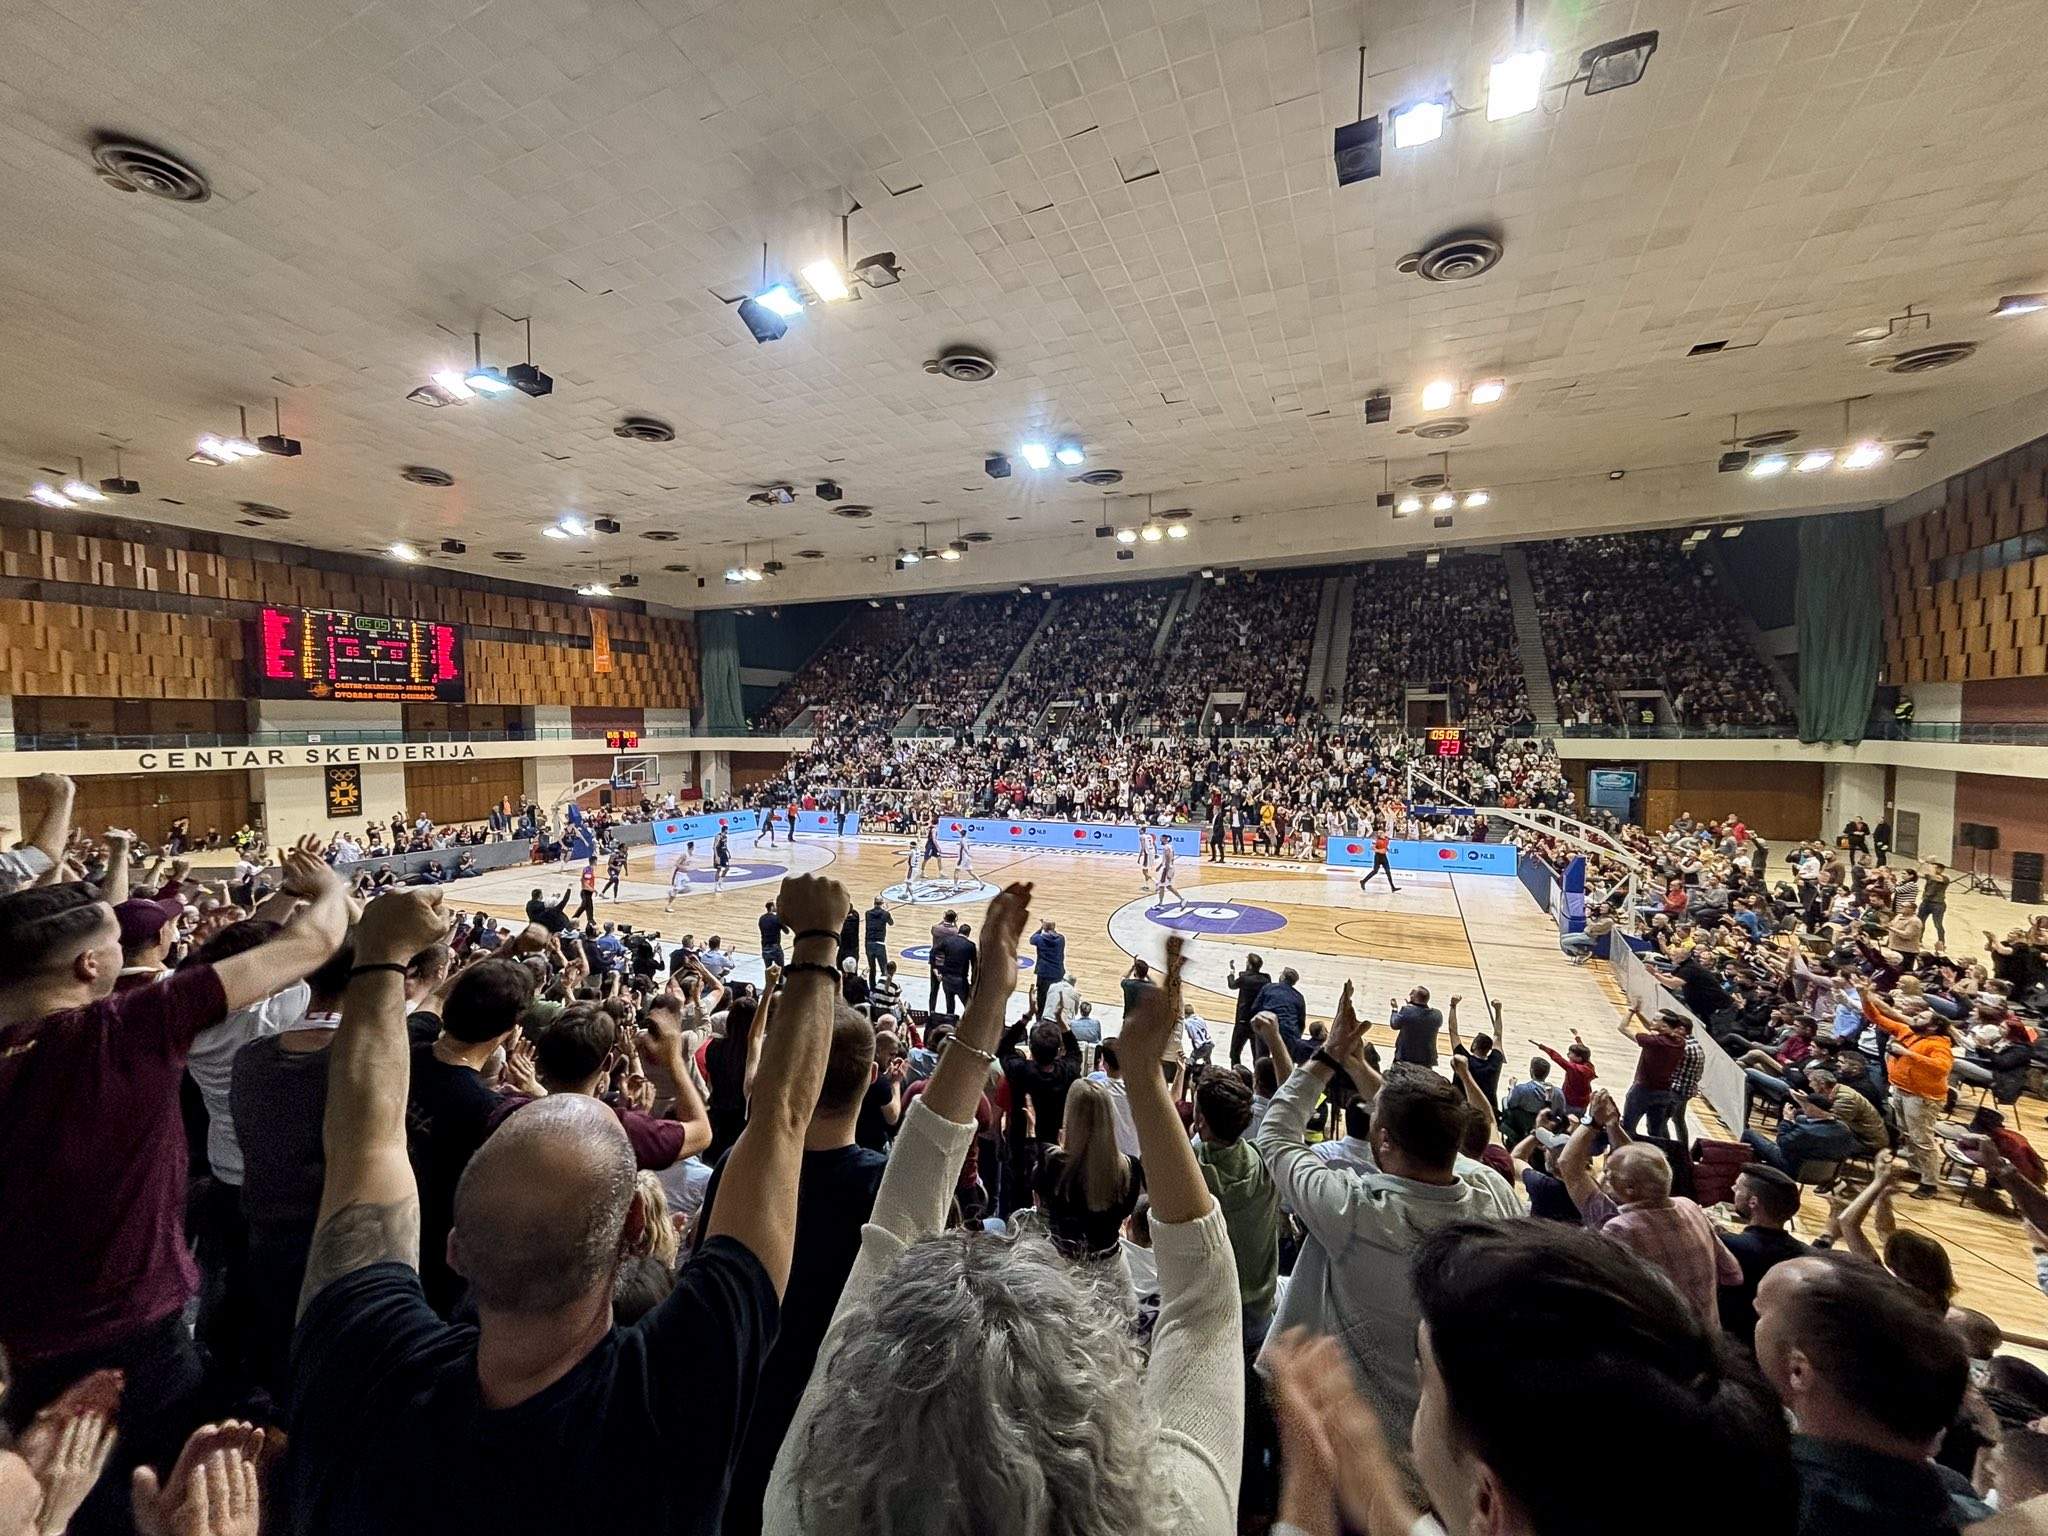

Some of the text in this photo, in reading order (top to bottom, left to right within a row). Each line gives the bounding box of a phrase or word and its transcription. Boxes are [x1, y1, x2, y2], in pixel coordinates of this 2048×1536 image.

[345, 646, 360, 657] 65
[390, 649, 403, 659] 53
[1439, 740, 1460, 754] 23
[139, 745, 474, 769] CENTAR SKENDERIJA
